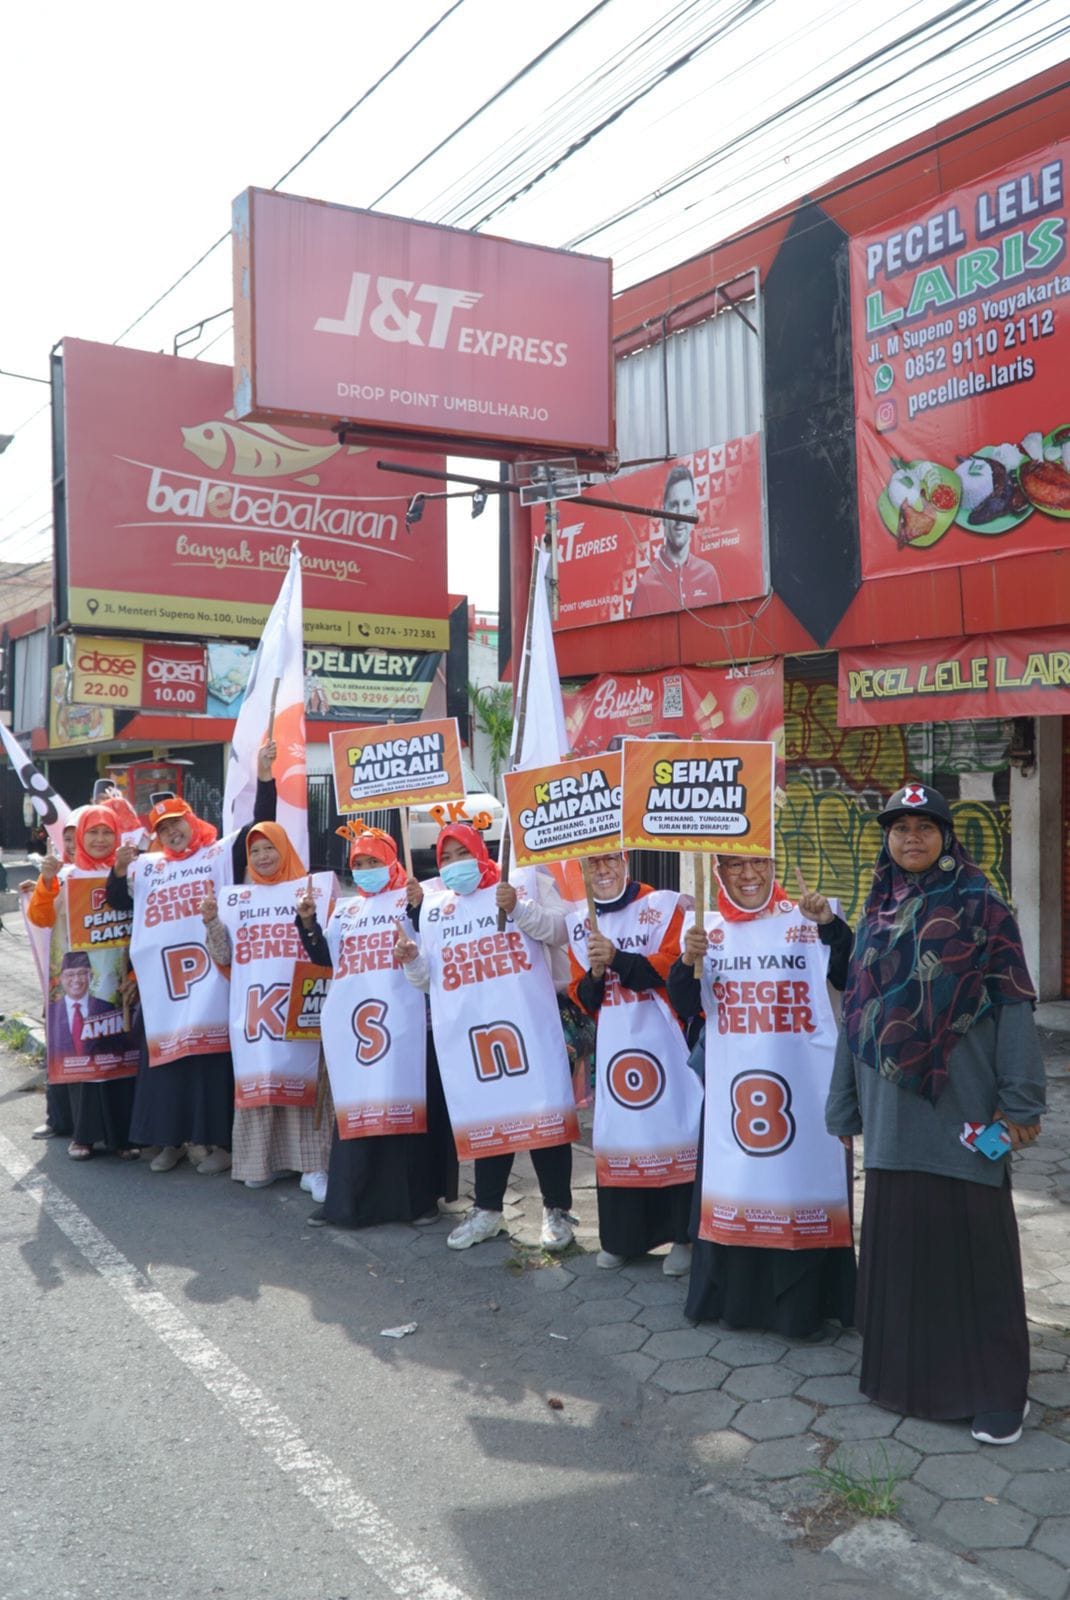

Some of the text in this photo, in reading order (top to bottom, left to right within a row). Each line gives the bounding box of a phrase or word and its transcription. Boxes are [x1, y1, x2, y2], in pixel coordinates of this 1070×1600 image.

[866, 162, 1064, 281] PECEL LELE
[866, 218, 1064, 333] LARIS
[314, 272, 568, 367] J&T EXPRESS
[887, 341, 900, 358] M
[903, 320, 954, 354] Supeno
[959, 309, 978, 332] 98
[982, 274, 1070, 325] Yogyakarta
[905, 310, 1055, 378] 0852 9110 2112
[336, 382, 549, 421] DROP POINT UMBULHARJO
[909, 361, 1035, 417] pecellele.laris
[176, 535, 360, 580] Banyak piliannya
[575, 534, 618, 559] EXPRESS
[119, 605, 157, 618] Menteri
[160, 608, 195, 623] Supeno
[374, 626, 396, 635] 0274
[560, 602, 577, 613] POINT
[78, 651, 136, 676] close
[147, 661, 204, 684] open
[306, 650, 419, 676] DELIVERY
[84, 682, 128, 698] 22.00
[848, 668, 914, 700] PECEL
[917, 657, 989, 693] LELE
[153, 687, 196, 703] 10.00
[347, 733, 442, 767] PANGAN
[353, 753, 440, 784] MURAH
[654, 758, 740, 785] SEHAT
[533, 769, 605, 805] KERJA
[647, 786, 743, 811] MUDAH
[519, 785, 622, 830] GAMPANG
[596, 812, 615, 824] JUTA
[573, 827, 598, 838] KERJA
[180, 865, 212, 880] YANG
[227, 893, 239, 907] 8
[239, 907, 270, 921] PILIH
[429, 907, 440, 922] 8
[248, 922, 300, 943] SEGE
[573, 922, 586, 942] 8
[616, 933, 649, 949] YAN
[453, 932, 524, 964] SEGER
[161, 943, 212, 1001] P
[710, 955, 807, 972] PILIH YANG
[724, 980, 811, 1006] SEGER
[352, 998, 391, 1067] S
[729, 1068, 796, 1158] 8
